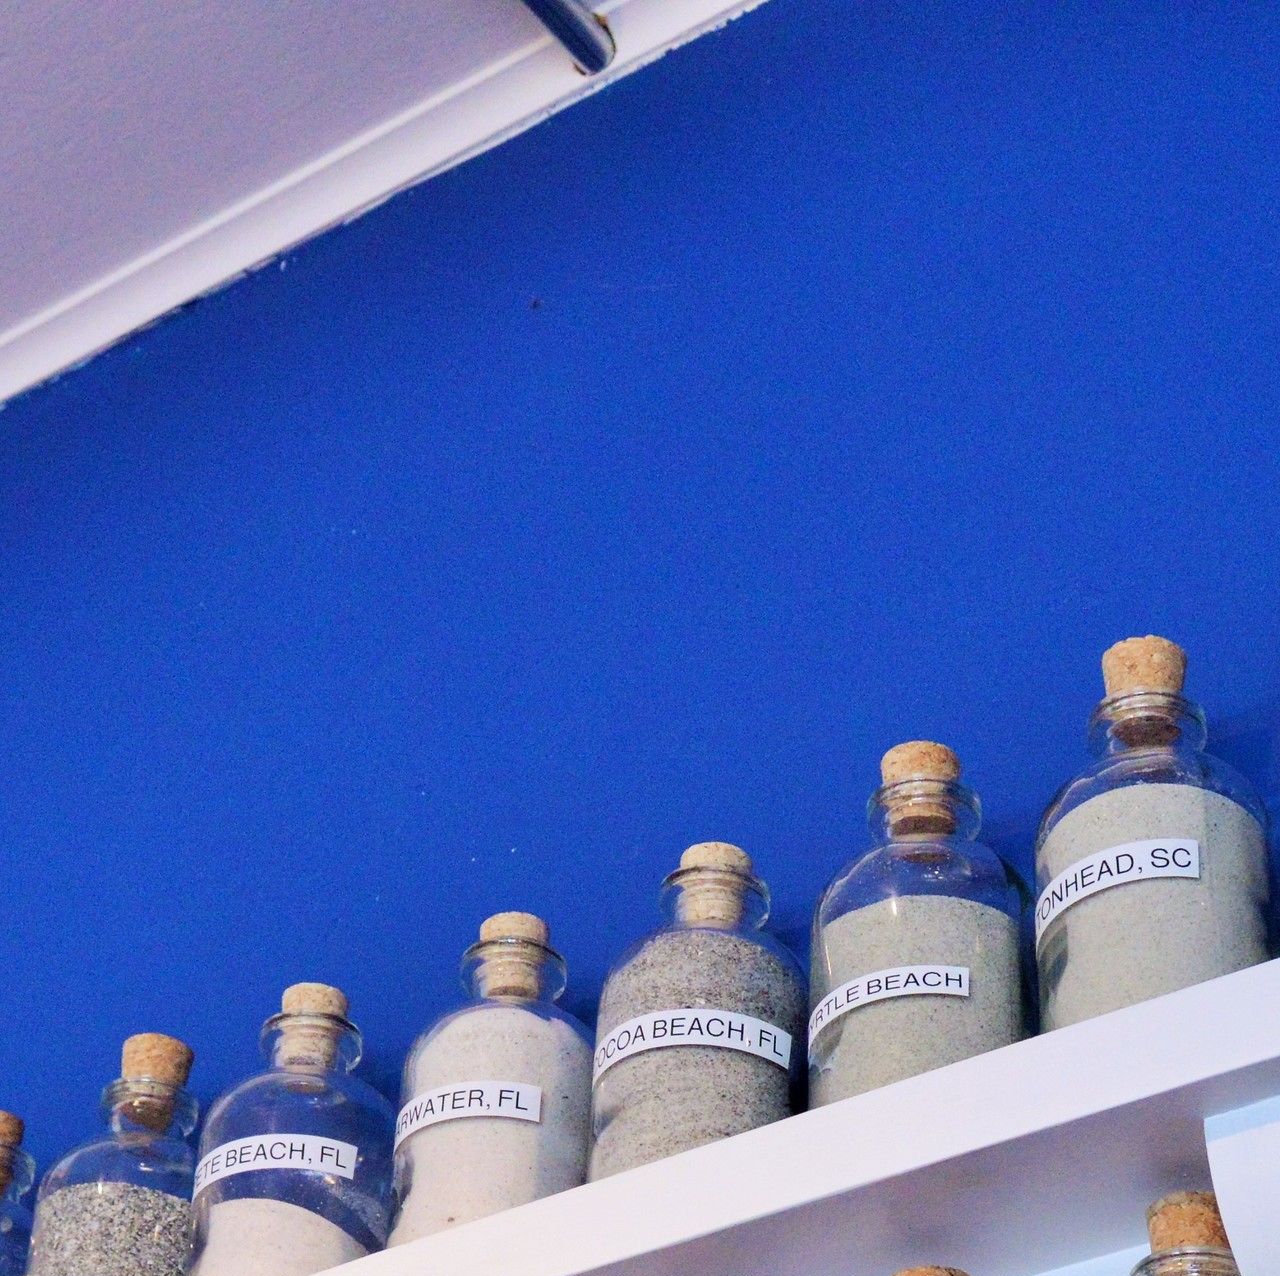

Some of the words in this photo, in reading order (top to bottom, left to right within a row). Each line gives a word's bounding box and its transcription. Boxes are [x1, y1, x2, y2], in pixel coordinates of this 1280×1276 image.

[1150, 848, 1192, 868] SC
[867, 971, 963, 996] BEACH
[595, 1025, 646, 1068] OCOA
[652, 1017, 752, 1047] BEACH,
[758, 1029, 784, 1057] FL
[498, 1089, 529, 1111] FL
[225, 1141, 312, 1169] BEACH,
[320, 1145, 347, 1169] FL
